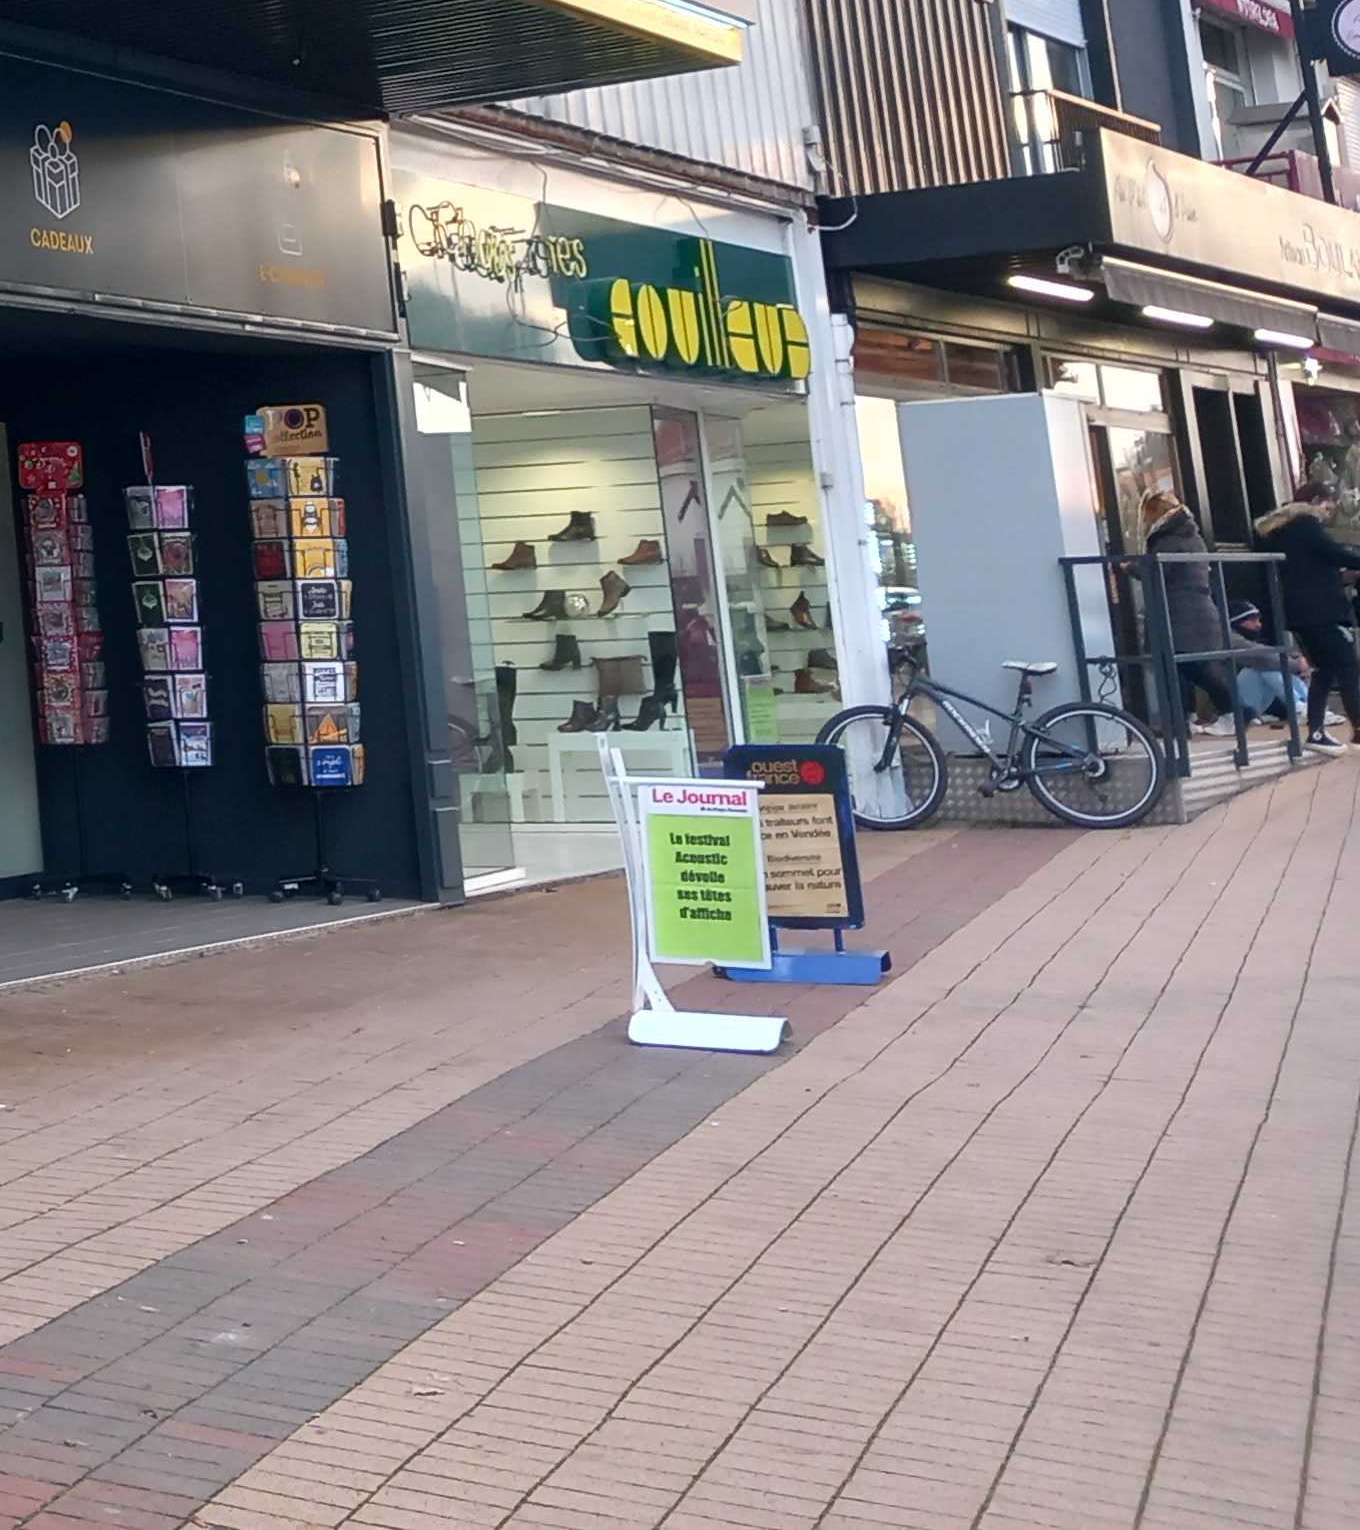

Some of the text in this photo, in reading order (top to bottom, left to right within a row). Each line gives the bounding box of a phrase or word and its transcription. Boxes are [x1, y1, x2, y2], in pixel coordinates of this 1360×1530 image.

[30, 227, 94, 255] CADEAUX
[751, 758, 798, 773] ouest
[652, 788, 748, 806] Le Journal
[685, 833, 731, 847] festival
[790, 828, 831, 839] Vendée
[675, 851, 728, 866] Acoustic
[770, 868, 815, 879] sommet
[764, 881, 792, 892] auver
